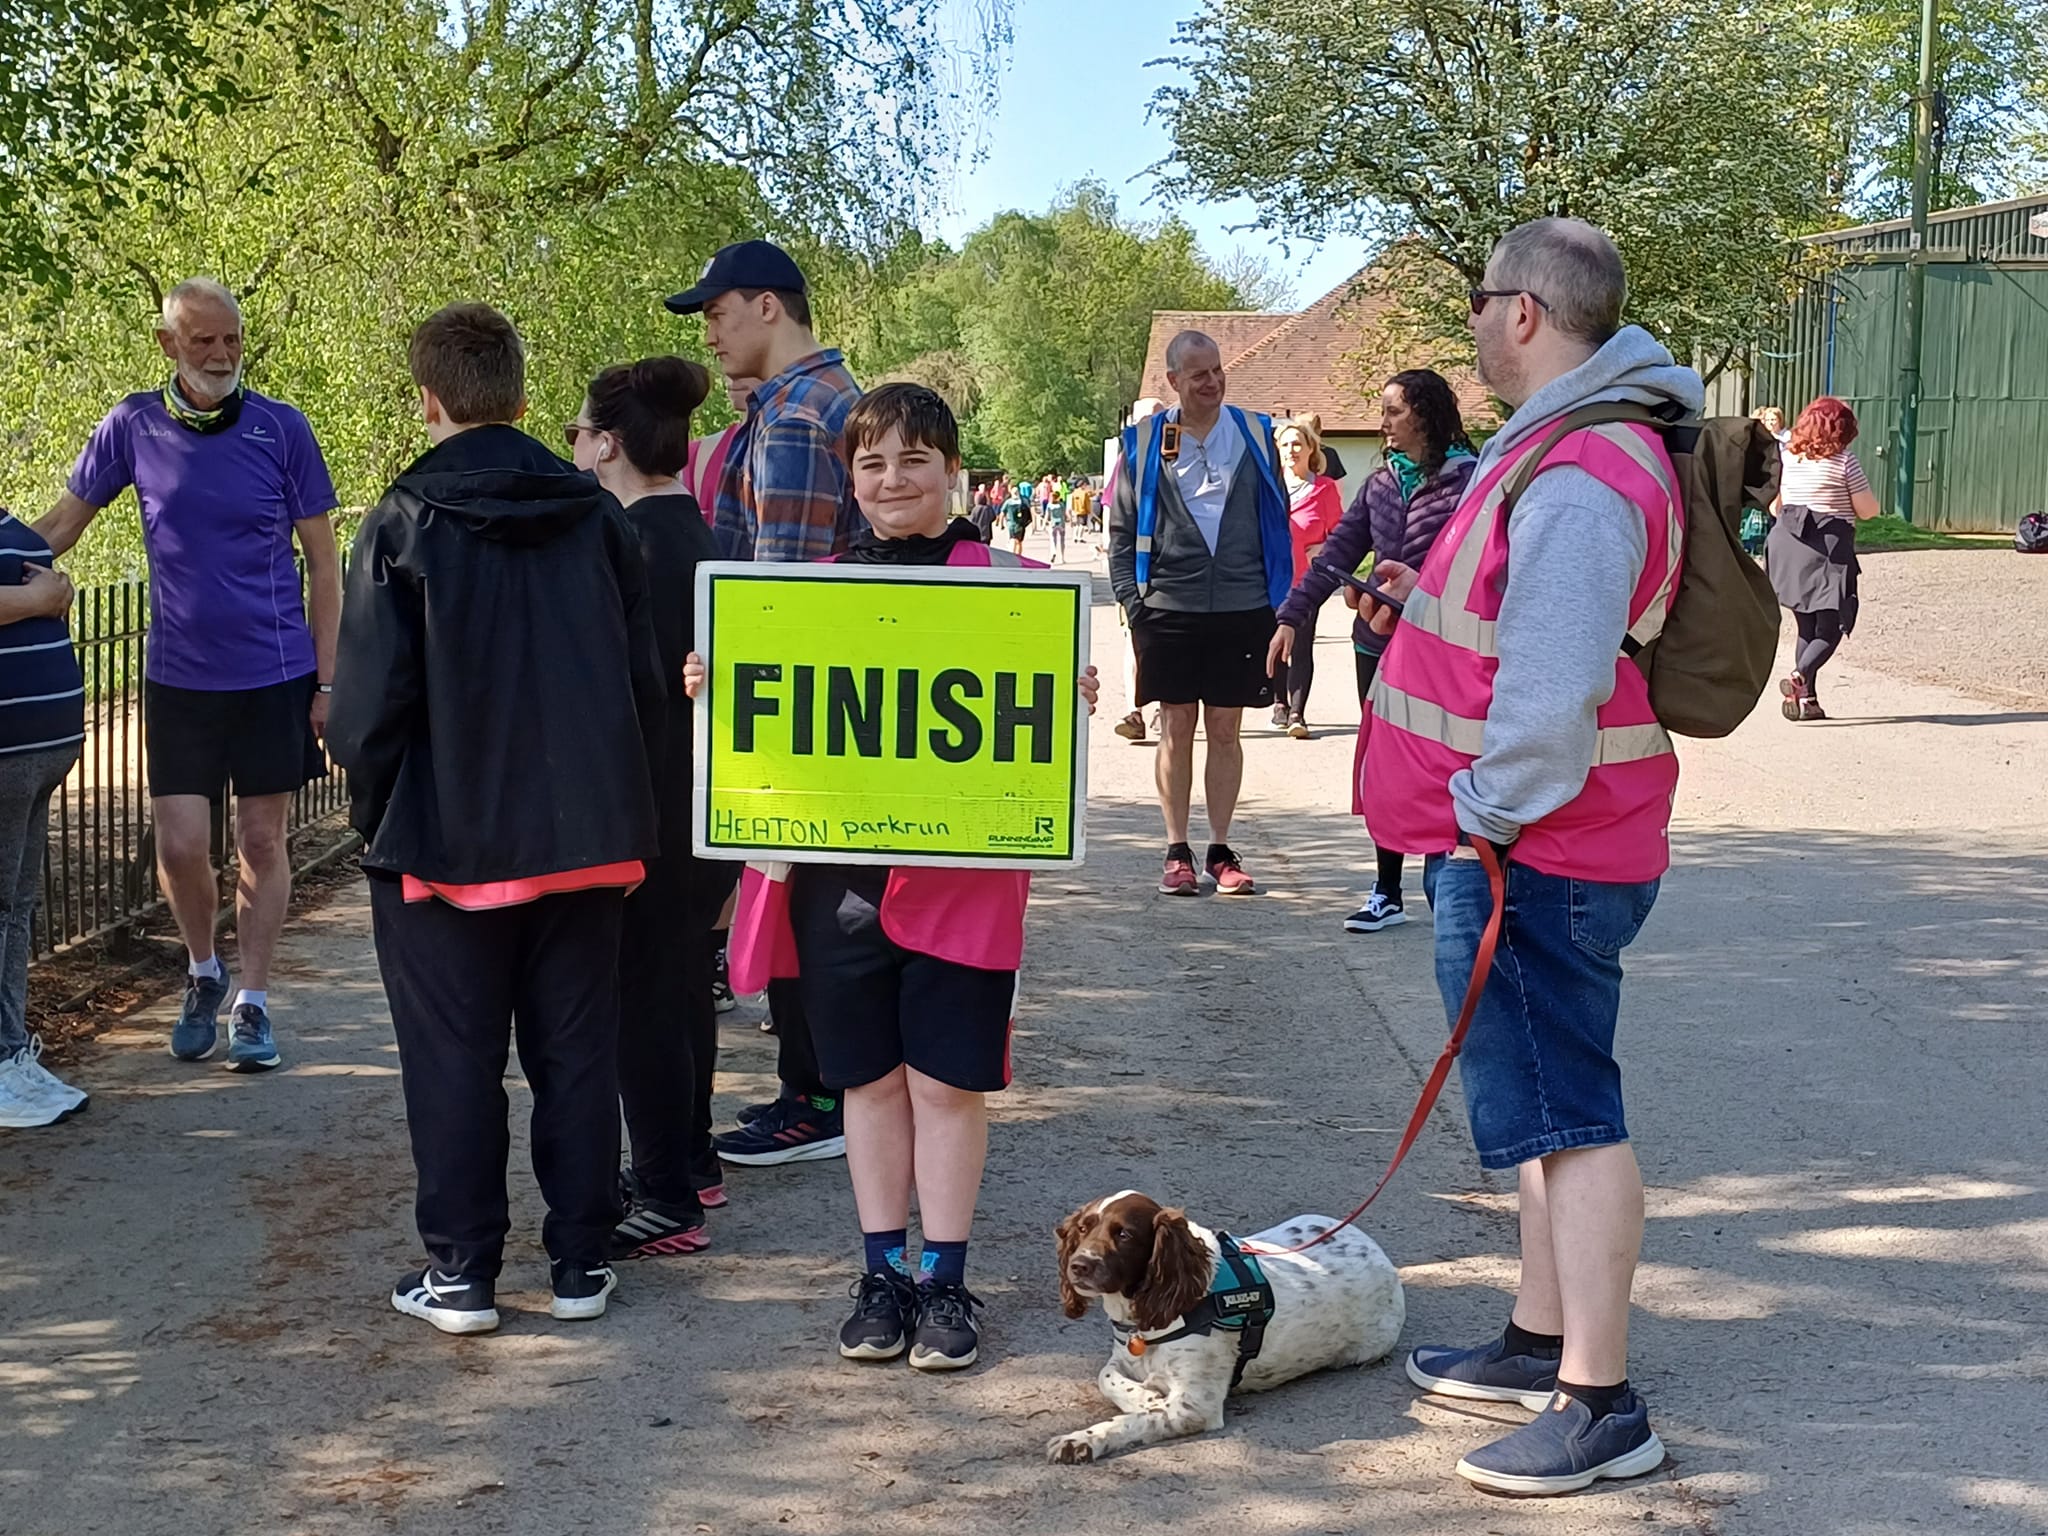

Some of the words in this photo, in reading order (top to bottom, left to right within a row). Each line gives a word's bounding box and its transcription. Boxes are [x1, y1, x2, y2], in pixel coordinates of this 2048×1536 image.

[733, 663, 1054, 763] FINISH
[715, 809, 828, 844] HEATON
[841, 815, 950, 842] parkrun
